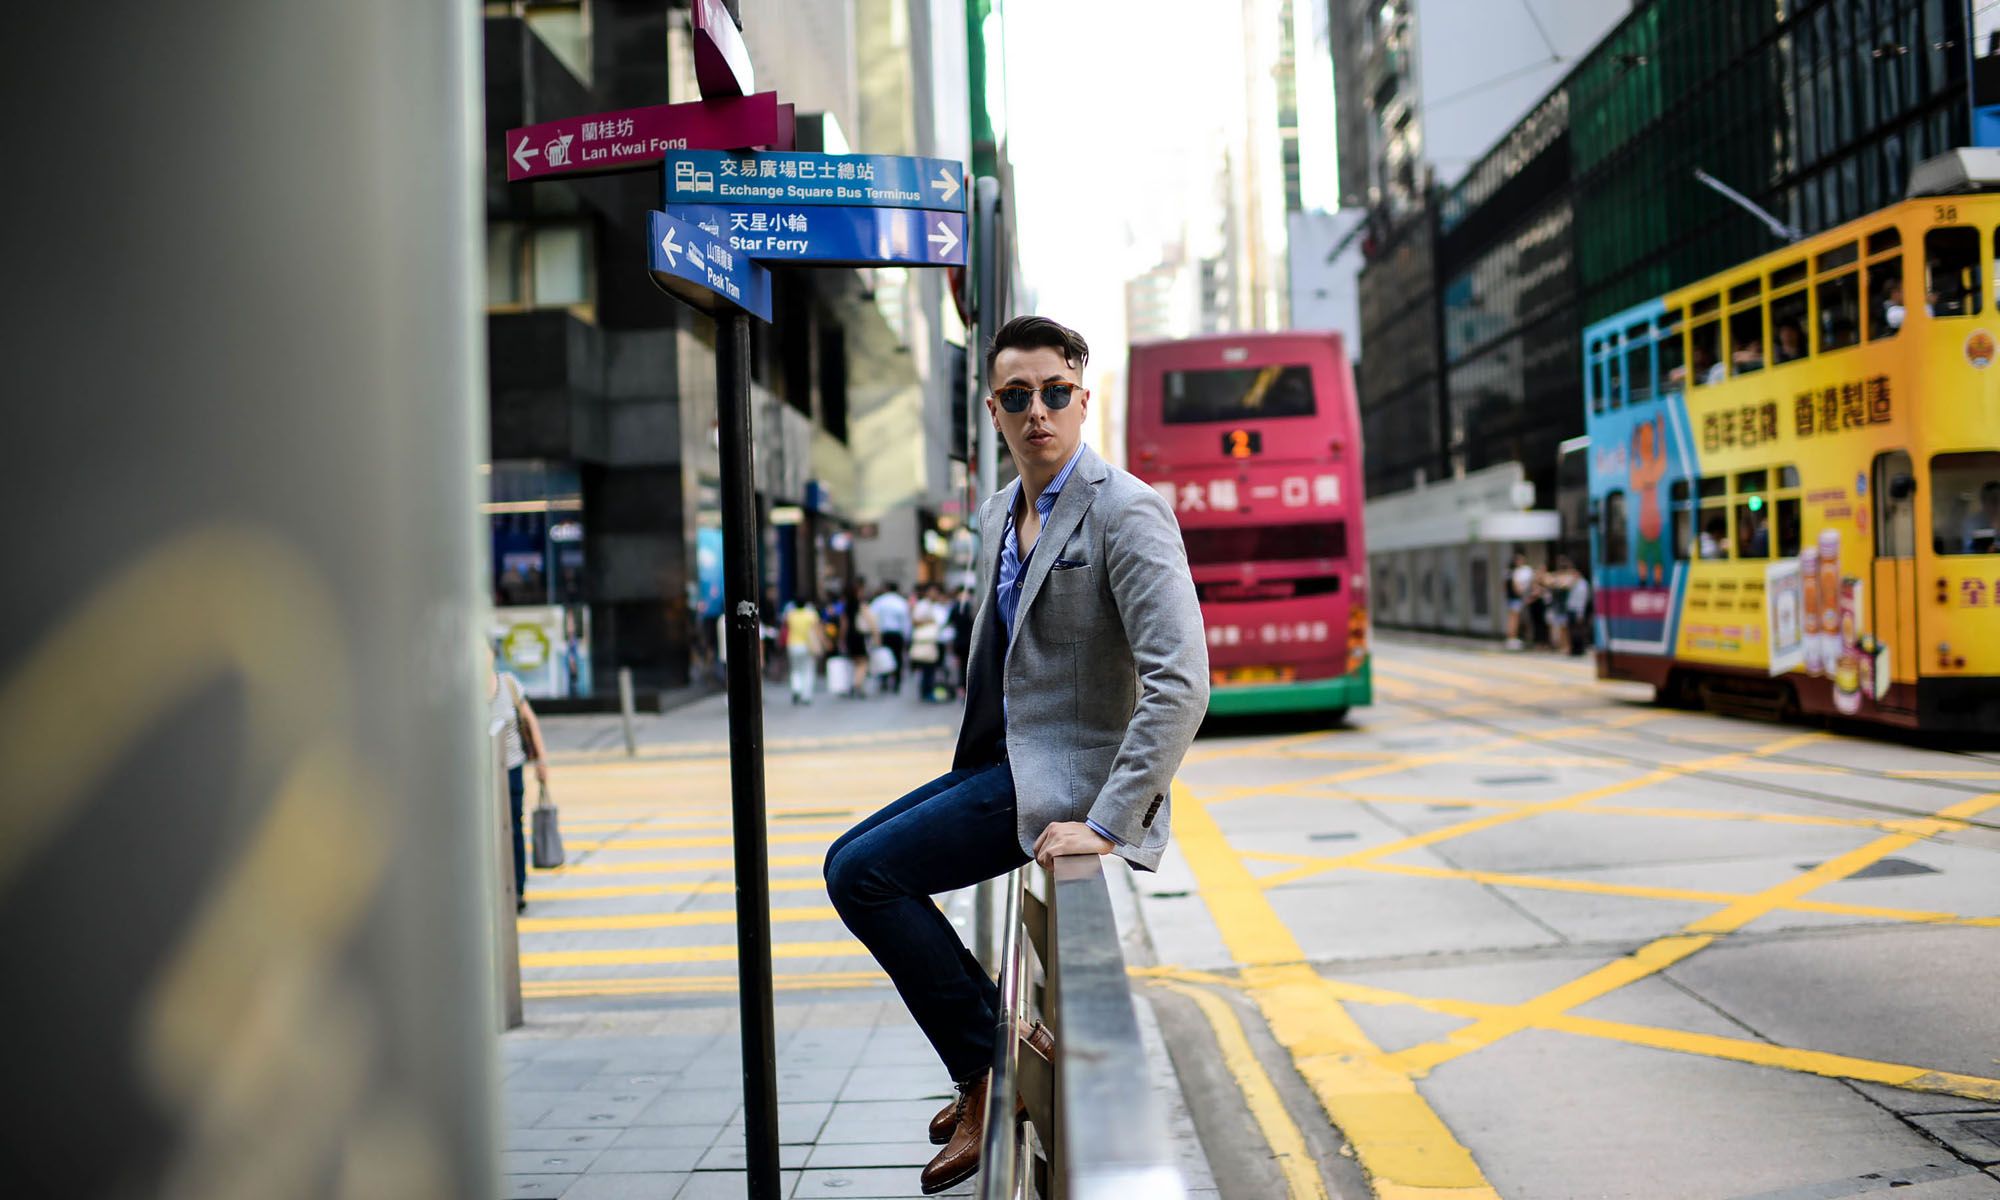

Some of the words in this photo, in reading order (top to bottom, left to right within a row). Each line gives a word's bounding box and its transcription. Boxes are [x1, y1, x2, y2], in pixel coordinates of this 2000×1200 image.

[582, 118, 634, 142] 蘭桂坊
[582, 147, 607, 161] Lan
[611, 140, 646, 157] Kwai
[650, 138, 687, 152] Fong
[720, 159, 875, 181] 交易廣場巴士總站
[720, 184, 784, 198] Exchange
[787, 185, 833, 199] Square
[837, 186, 862, 199] Bus
[865, 187, 921, 201] Terminus
[730, 213, 808, 233] 天星小輪
[706, 241, 733, 271] 山頂纜車
[729, 236, 763, 250] Star
[766, 237, 808, 254] Ferry
[707, 266, 724, 290] Peak
[725, 276, 739, 299] Tram
[1795, 374, 1892, 437] 香港製造
[1231, 430, 1250, 458] 2
